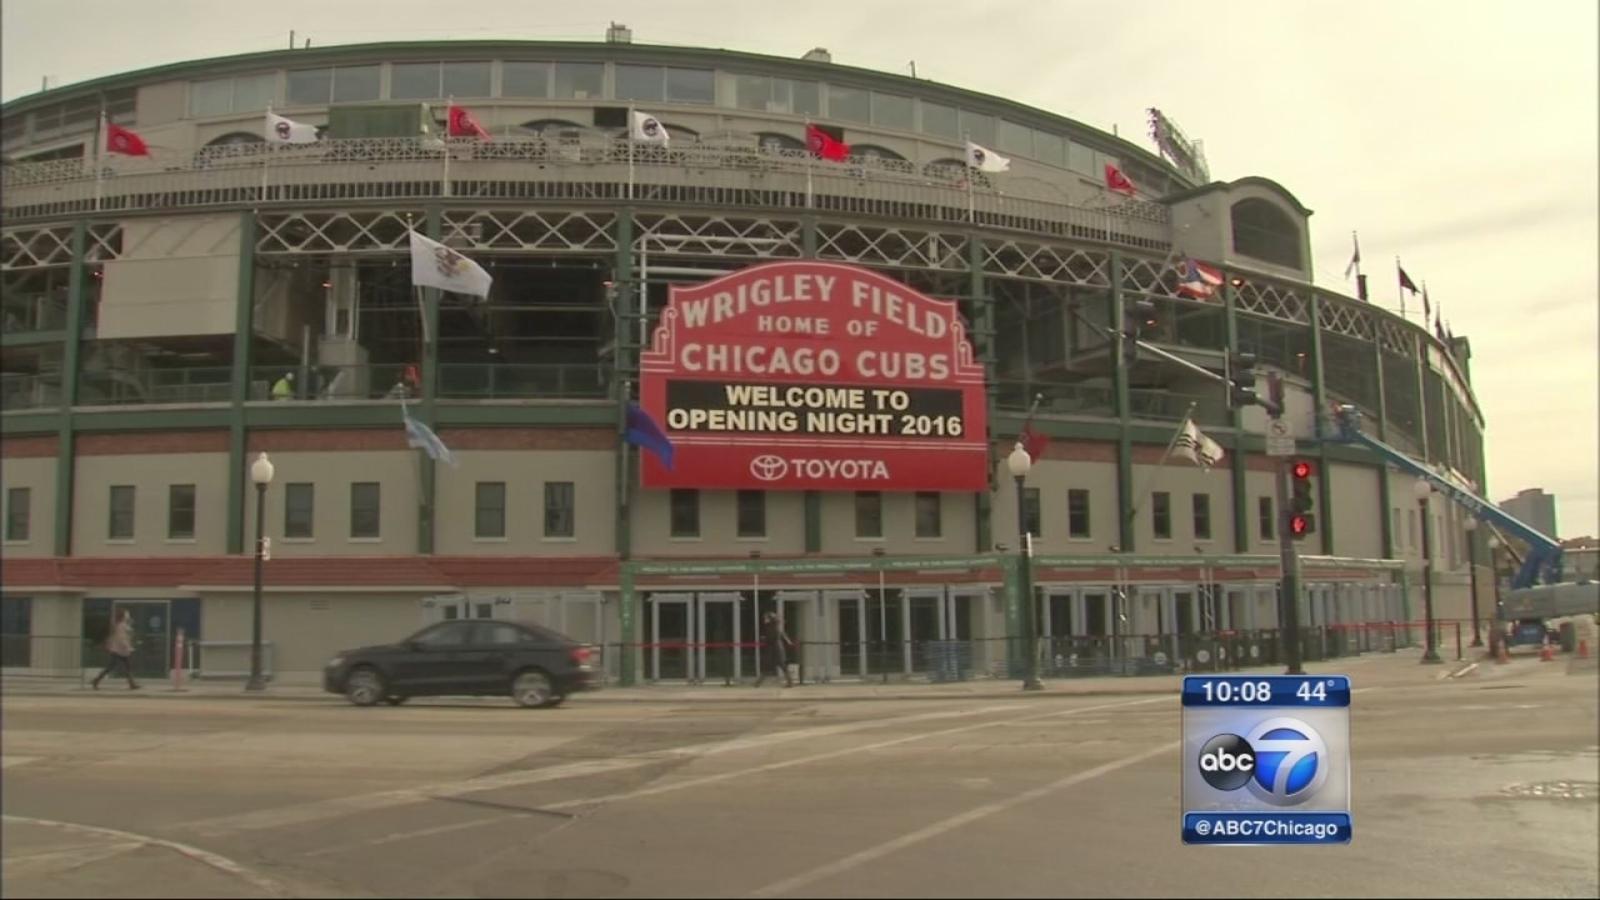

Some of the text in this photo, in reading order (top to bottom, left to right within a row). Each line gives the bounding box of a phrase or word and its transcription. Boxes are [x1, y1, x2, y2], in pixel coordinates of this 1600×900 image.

[682, 274, 946, 338] WRIGLEY FIELD
[758, 315, 879, 336] HOME OF
[681, 343, 950, 380] CHICAGO CUBS
[726, 385, 909, 410] WELCOME TO
[668, 409, 962, 435] OPENING NIGHT 2016
[791, 459, 889, 479] TOYOTA
